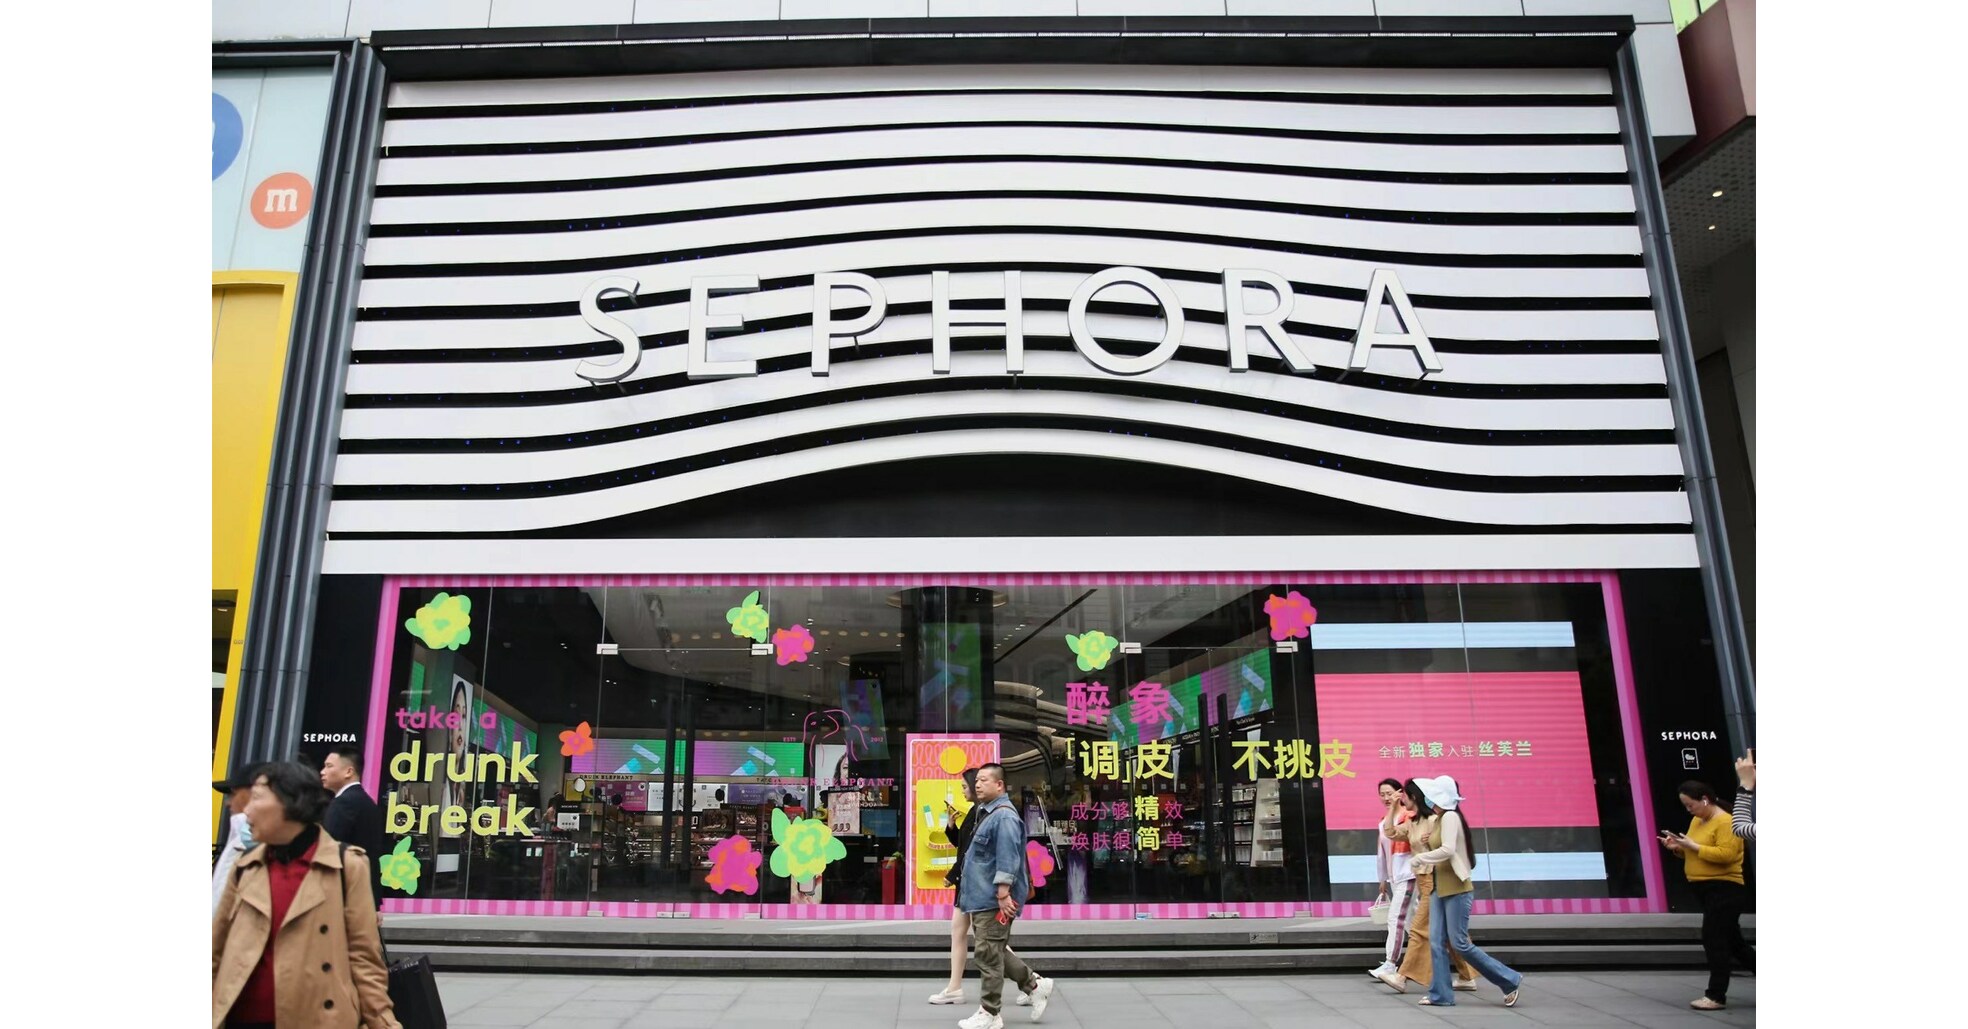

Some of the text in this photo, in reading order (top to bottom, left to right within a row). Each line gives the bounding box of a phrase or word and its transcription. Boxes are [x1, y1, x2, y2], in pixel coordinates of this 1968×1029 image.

[264, 188, 298, 212] m
[575, 267, 1443, 382] SEPHORA
[395, 705, 497, 730] take a
[1066, 682, 1172, 726] 醉象
[303, 733, 357, 743] SEPHORA
[1661, 731, 1717, 741] SEPHORA
[389, 740, 539, 783] drunk
[1231, 738, 1357, 781] 不挑皮
[385, 792, 535, 836] break
